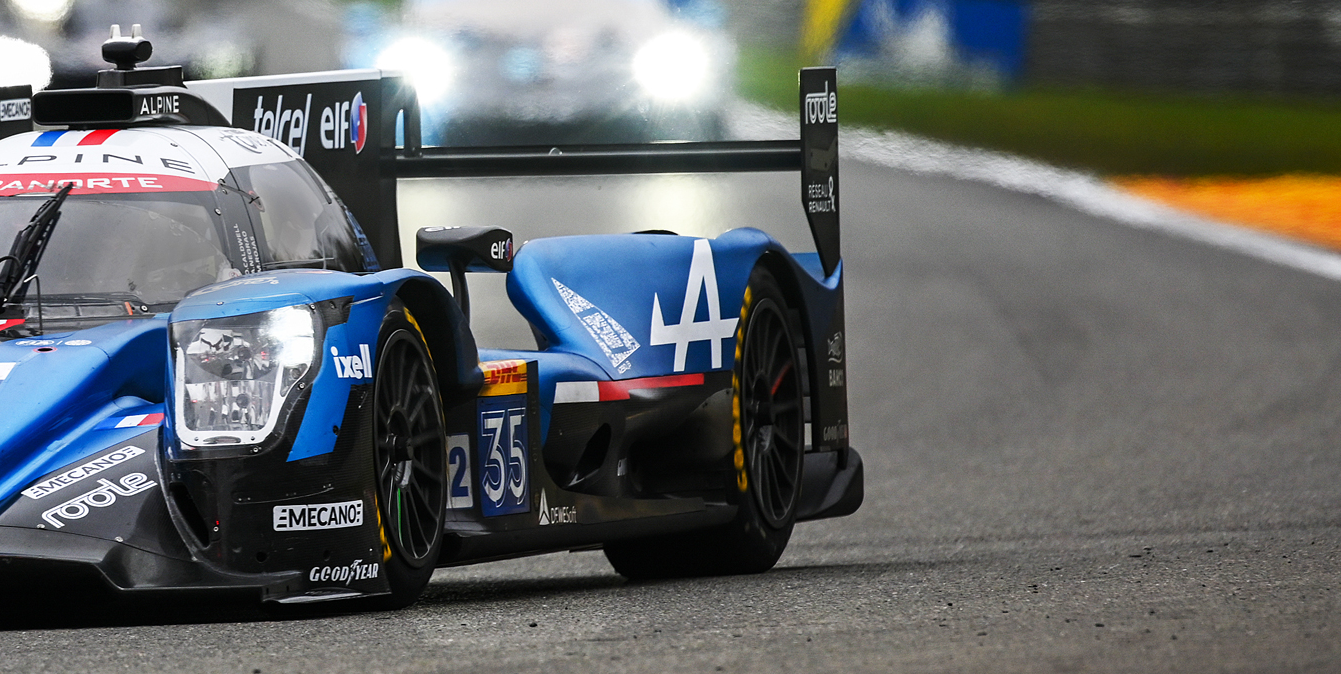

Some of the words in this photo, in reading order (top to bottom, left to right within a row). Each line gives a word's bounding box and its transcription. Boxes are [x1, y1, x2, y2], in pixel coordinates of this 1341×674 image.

[140, 95, 180, 115] ALPINE
[320, 101, 350, 149] elf
[808, 200, 831, 213] RENAULT
[490, 240, 506, 260] elf
[330, 343, 373, 380] ixell
[486, 361, 522, 385] DHL
[482, 407, 527, 508] 35
[309, 560, 379, 585] GOODYEAR
